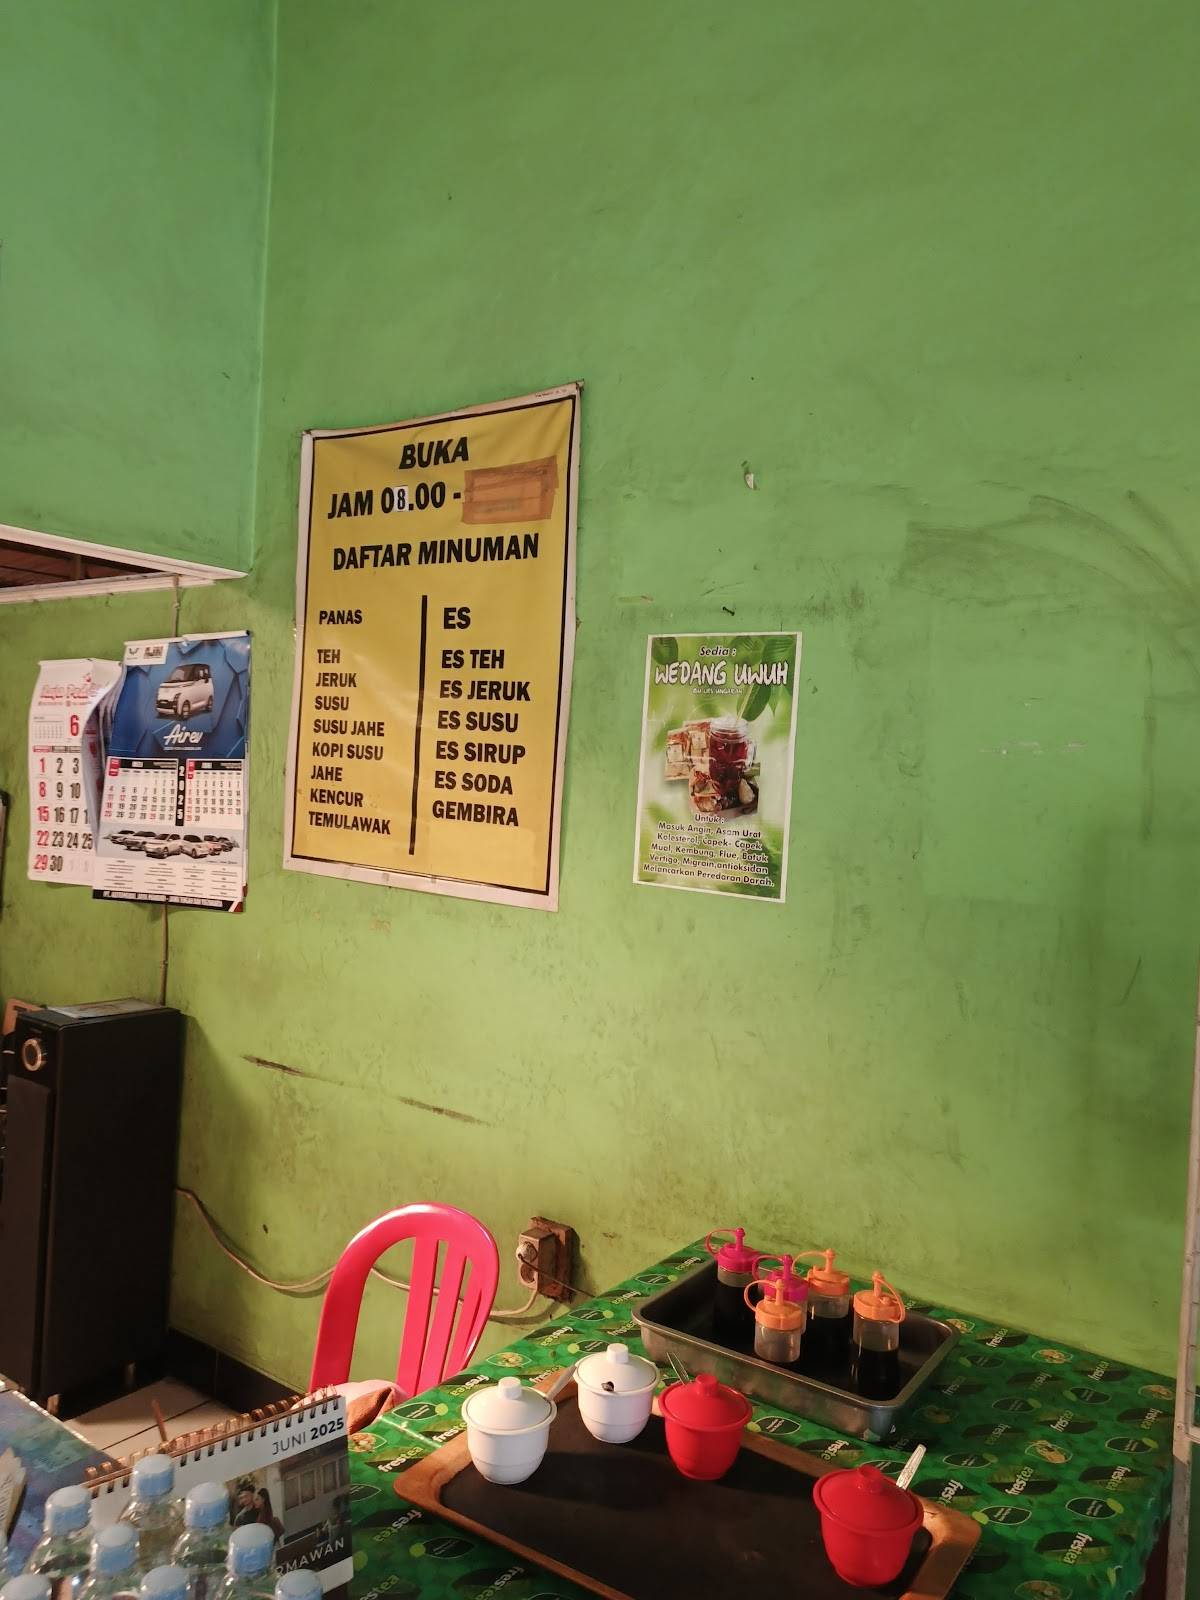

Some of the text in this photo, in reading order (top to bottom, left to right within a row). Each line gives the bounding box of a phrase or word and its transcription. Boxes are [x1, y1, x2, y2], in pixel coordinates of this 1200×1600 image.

[399, 437, 469, 469] BUKA
[328, 490, 373, 519] JAM
[381, 481, 446, 514] 08.00
[333, 533, 539, 571] DAFTAR MINUMAN
[319, 610, 362, 625] PANAS
[443, 607, 471, 629] ES
[317, 649, 341, 664] TEH
[441, 649, 505, 669] ES TEH
[700, 646, 729, 656] Sedia
[316, 672, 357, 688] JERUK
[655, 660, 789, 686] WEDANG UWUH
[439, 680, 531, 701] ES JERUK
[314, 695, 349, 711] SUSU
[70, 715, 79, 736] 6
[313, 719, 385, 737] SUSU JAHE
[437, 710, 519, 733] ES SUSU
[312, 742, 384, 761] KOPI SUSU
[435, 740, 526, 765] ES SIRUP
[40, 757, 80, 774] 1 2 3
[311, 765, 343, 782] JAHE
[39, 781, 80, 799] 8 9 10
[434, 770, 513, 795] ES SODA
[310, 788, 364, 808] KENCUR
[37, 805, 89, 824] 15 16 17 1
[308, 811, 391, 835] TEMULAWAK
[432, 800, 519, 827] GEMBIRA
[695, 814, 718, 823] Untuk
[37, 830, 93, 850] 22 23 24 25
[659, 822, 761, 838] Masuk Angin, Asam Urat
[34, 854, 48, 871] 29
[50, 855, 63, 872] 30
[643, 864, 695, 877] Melancarkan
[697, 870, 741, 882] Peredaran
[272, 1417, 344, 1455] JUNI 2025
[377, 1447, 423, 1472] frestea
[1005, 1466, 1033, 1495] frestea
[1063, 1532, 1093, 1565] frestea
